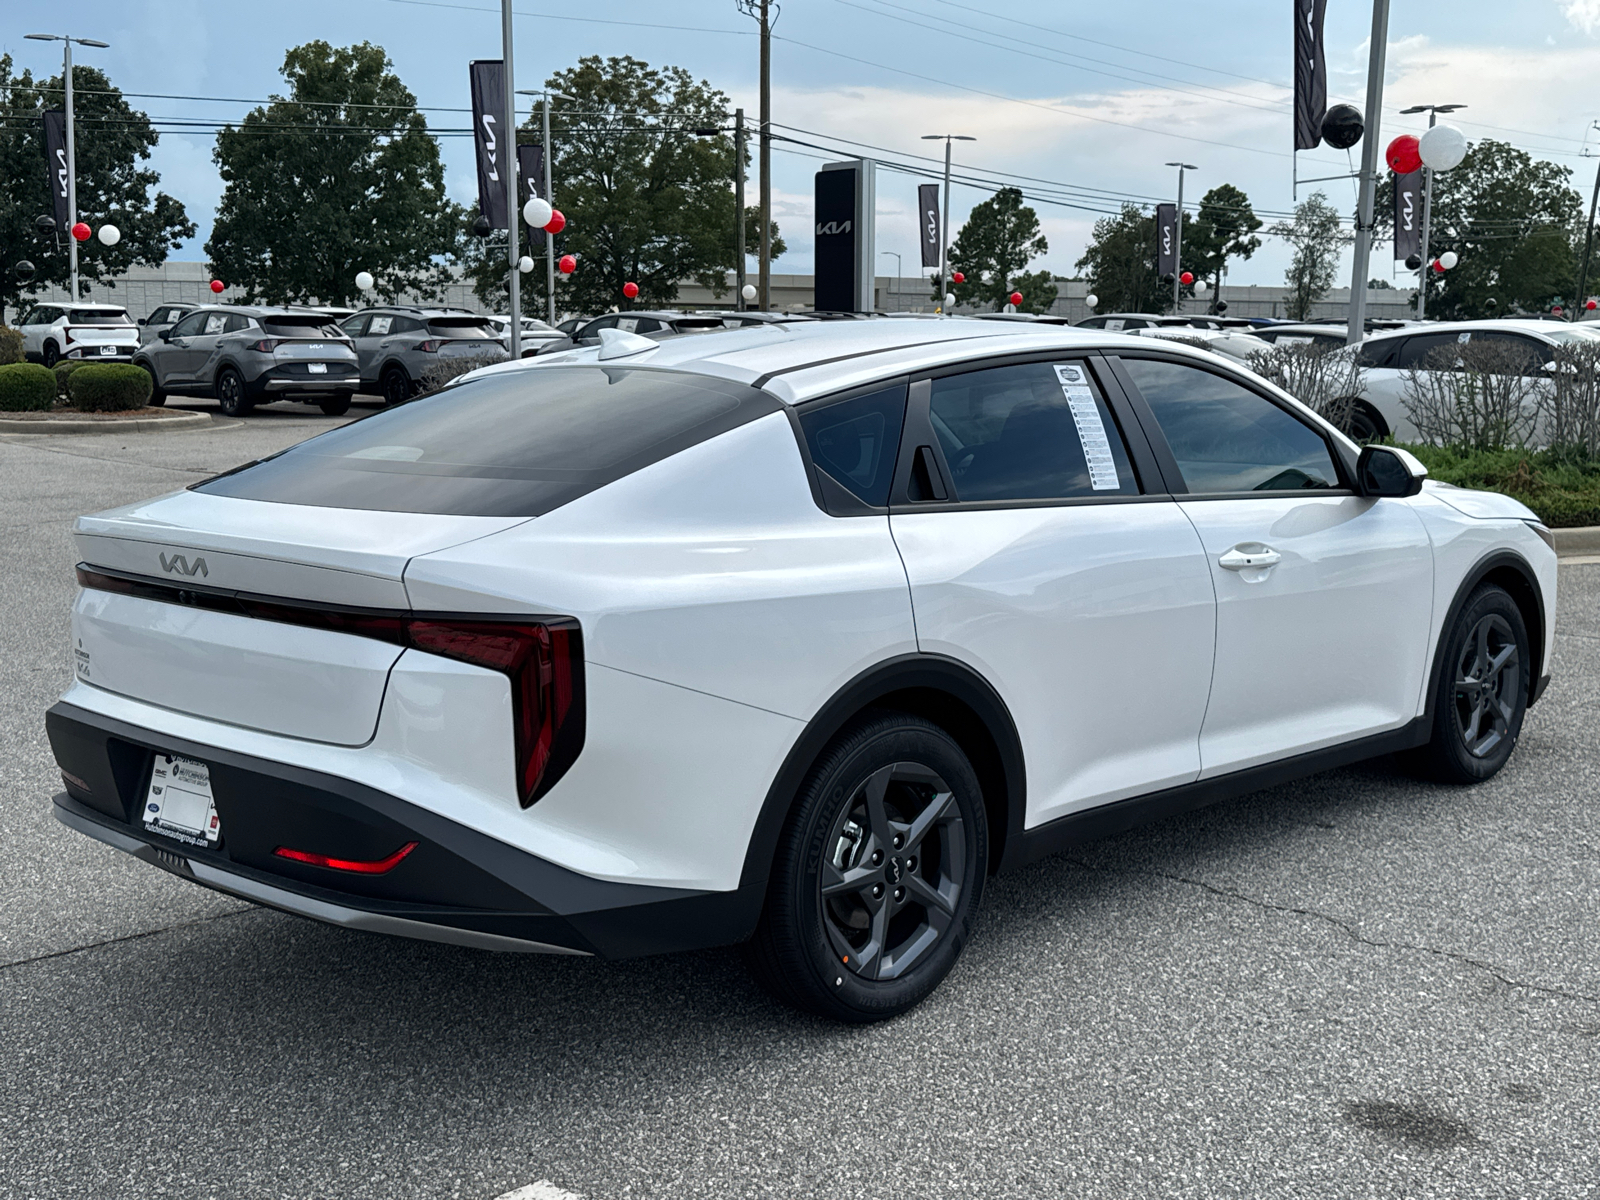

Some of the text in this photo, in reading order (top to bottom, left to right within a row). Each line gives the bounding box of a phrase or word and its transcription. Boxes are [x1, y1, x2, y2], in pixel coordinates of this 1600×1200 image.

[482, 114, 499, 181] KIA
[927, 210, 936, 243] KIA
[1402, 191, 1413, 231] KIA
[816, 220, 852, 235] KIA
[1163, 225, 1171, 255] KIA
[159, 551, 209, 578] KIA
[808, 785, 845, 875] KUMHO
[891, 857, 900, 883] KIA
